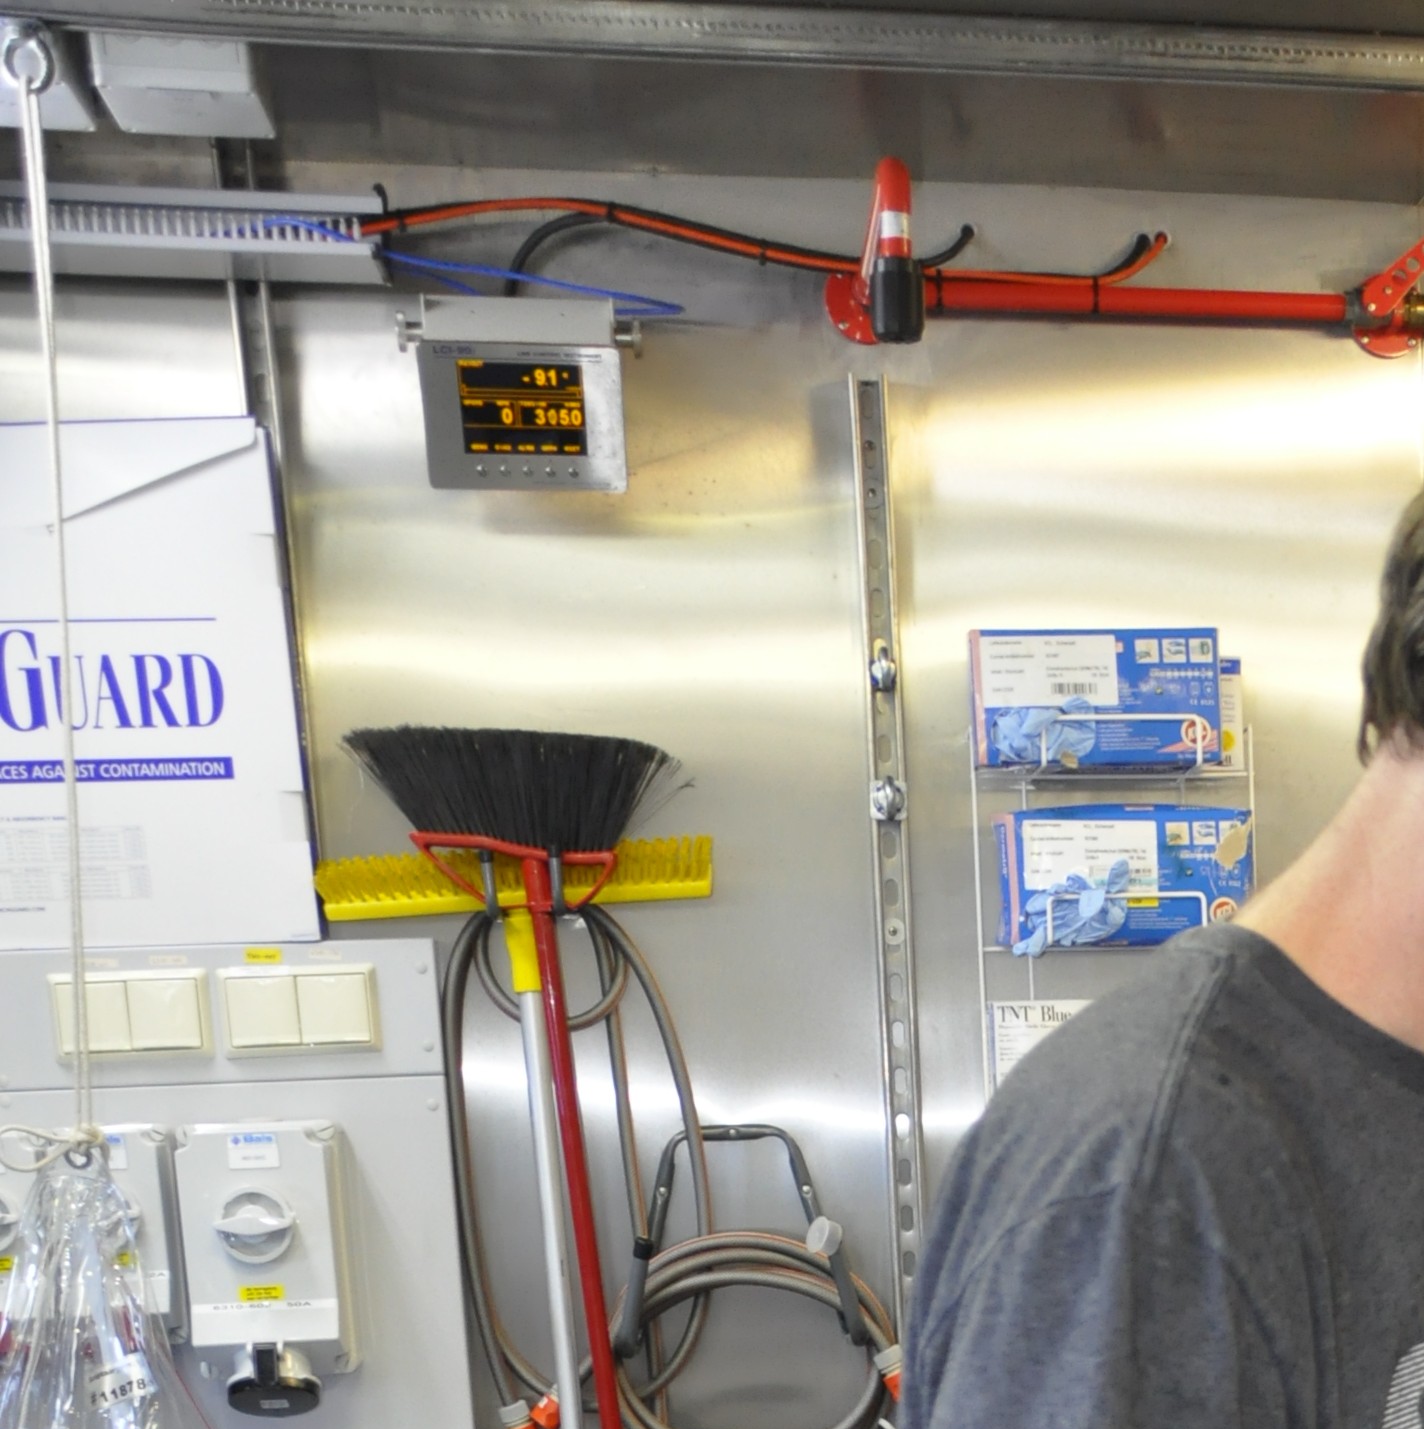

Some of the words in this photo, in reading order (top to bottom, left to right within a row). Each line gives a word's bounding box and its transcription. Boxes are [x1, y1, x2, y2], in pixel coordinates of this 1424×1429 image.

[32, 764, 96, 780] AGANST
[101, 762, 225, 778] CONTAMINATION
[997, 1005, 1029, 1023] TNT
